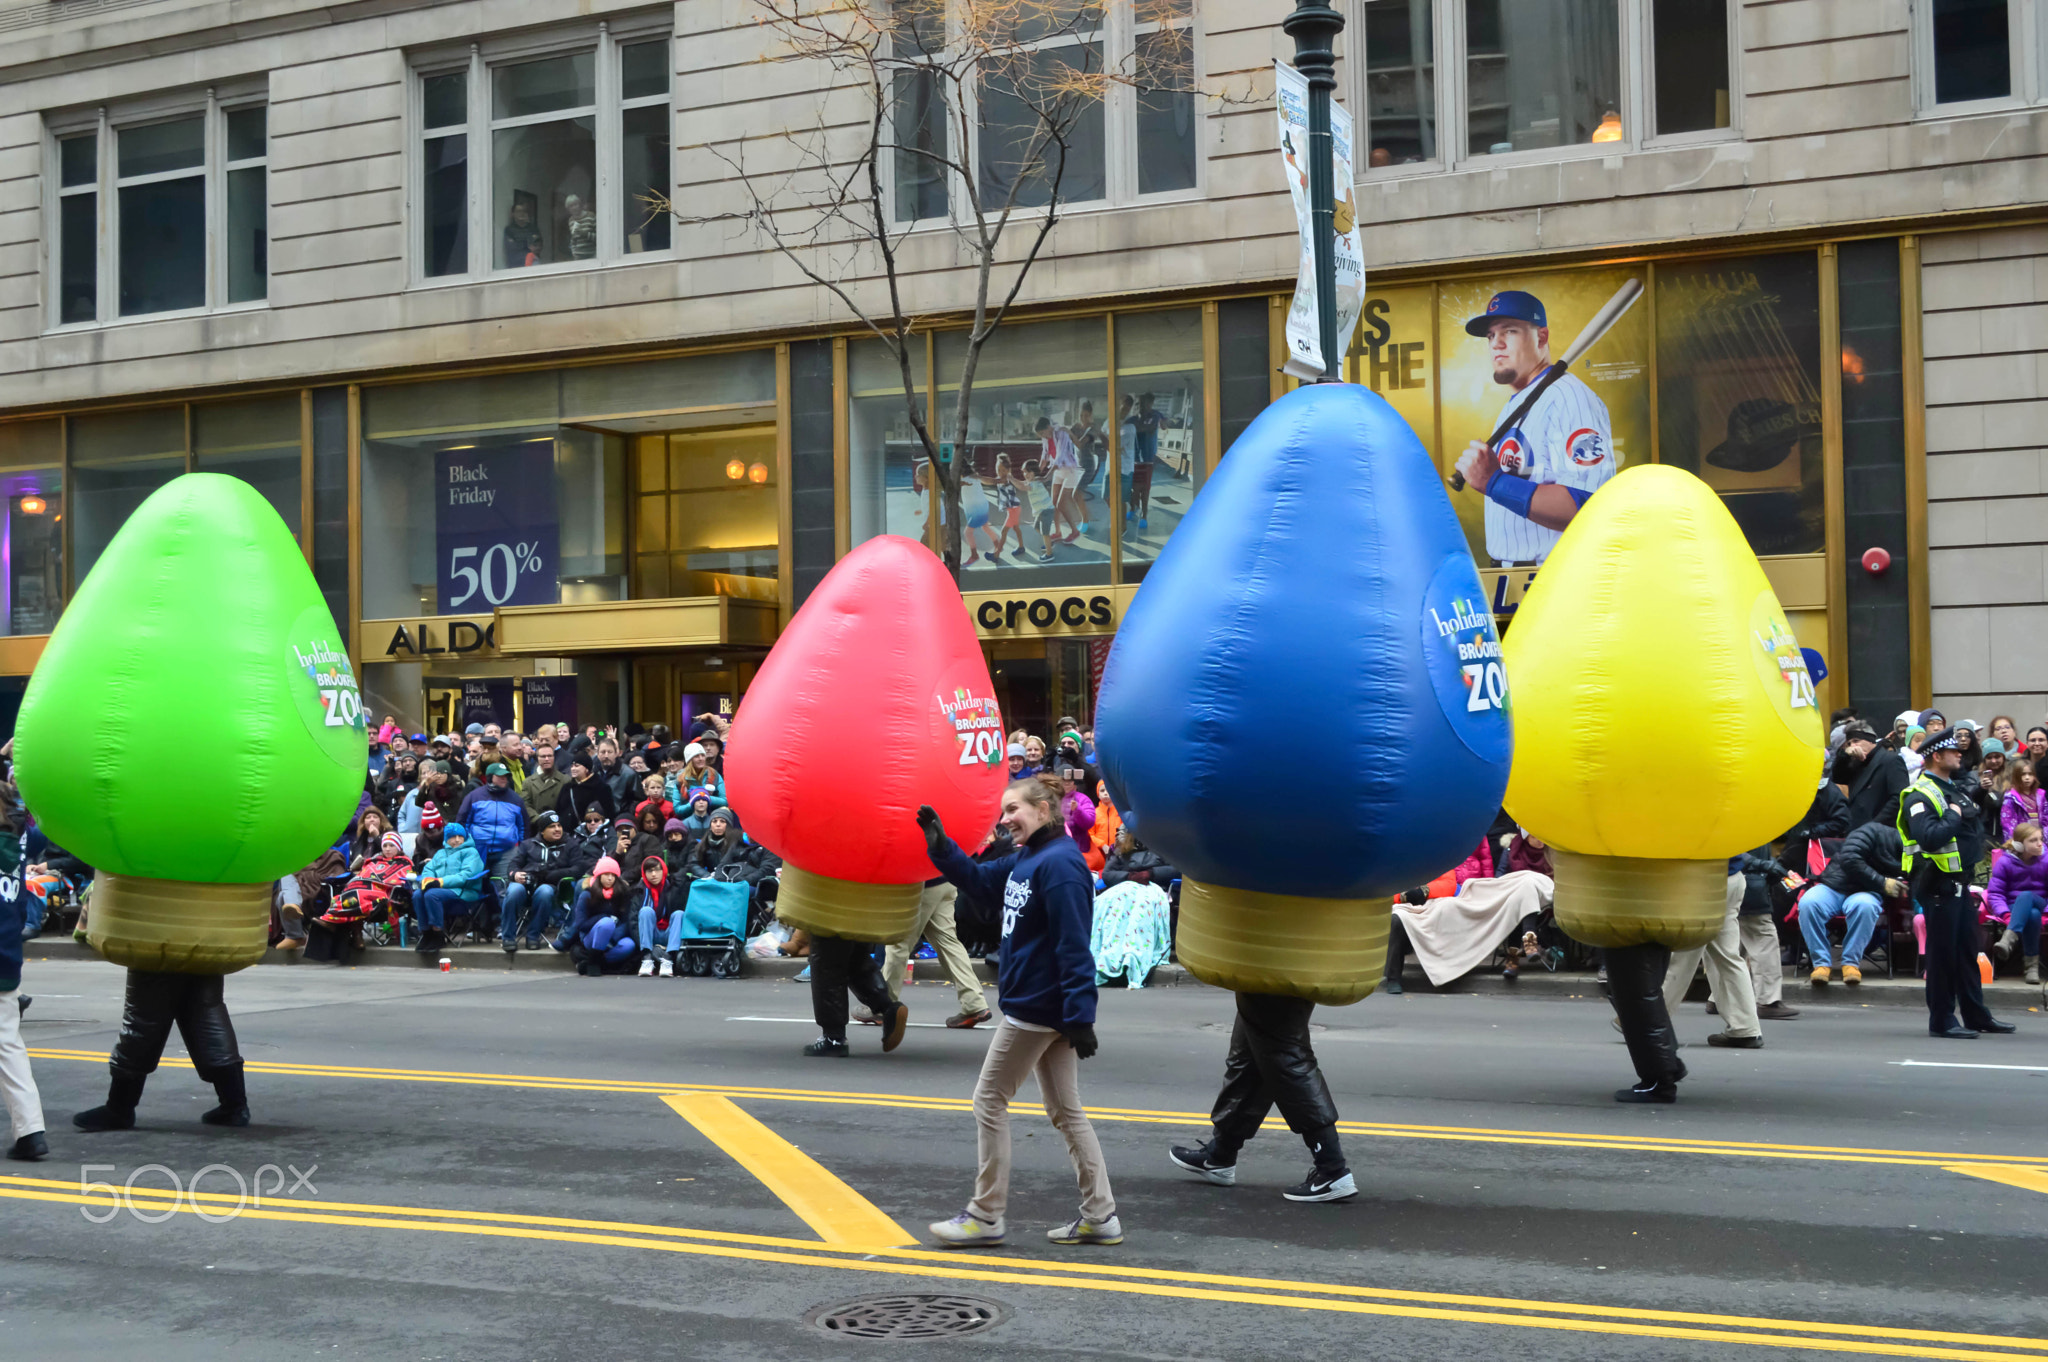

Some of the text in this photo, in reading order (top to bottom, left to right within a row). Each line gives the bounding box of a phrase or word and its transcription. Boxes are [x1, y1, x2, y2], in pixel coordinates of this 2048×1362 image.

[1345, 341, 1426, 391] THE
[449, 464, 489, 483] Black
[449, 486, 496, 507] Friday
[450, 541, 543, 607] 50%
[977, 595, 1112, 630] crocs
[1429, 598, 1488, 637] holiday
[292, 639, 341, 668] holiday
[465, 682, 489, 694] Black
[527, 681, 551, 692] Black
[527, 693, 555, 707] Friday
[465, 696, 492, 708] Friday
[936, 688, 984, 715] holiday
[957, 730, 1004, 766] ZOO
